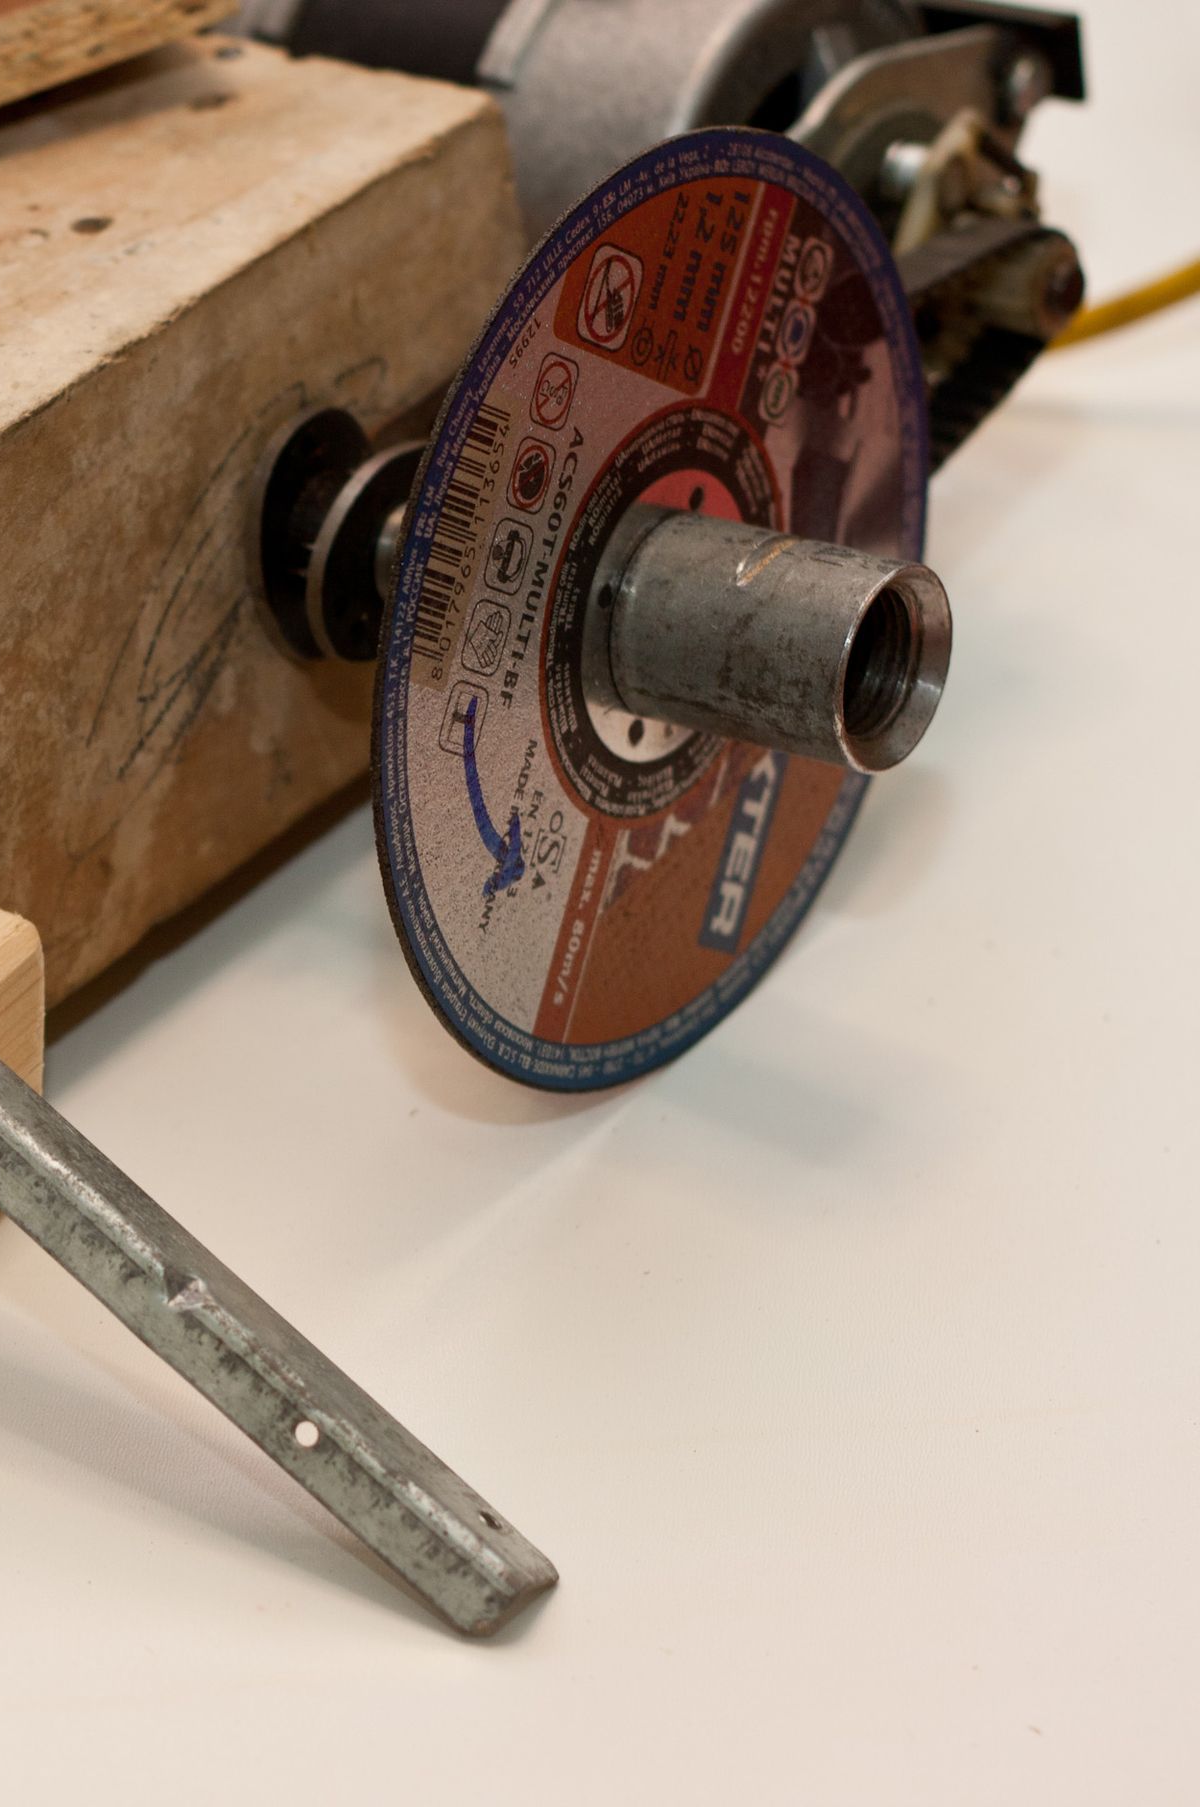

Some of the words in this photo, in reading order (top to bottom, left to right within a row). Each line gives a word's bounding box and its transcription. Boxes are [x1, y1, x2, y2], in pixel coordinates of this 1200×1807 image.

[663, 190, 689, 259] 22,23
[696, 190, 724, 244] 1,2
[720, 191, 751, 255] 125
[649, 261, 669, 311] mm
[673, 250, 703, 323] mm
[697, 261, 728, 333] mm
[757, 235, 803, 355] MULTI
[508, 317, 542, 370] 12995
[392, 600, 407, 644] 14122
[435, 438, 451, 467] Rue
[447, 384, 474, 437] Chanzy
[525, 266, 542, 295] 712
[542, 239, 564, 272] LILLE
[564, 210, 591, 246] Cedex
[431, 665, 444, 682] 8
[438, 544, 478, 654] 017965
[472, 420, 511, 528] 113654
[500, 425, 585, 711] ACS60T-MULTI-BF
[513, 738, 538, 801] MADE
[526, 789, 545, 820] EN
[709, 749, 777, 937] XTER
[578, 849, 603, 910] max.
[553, 918, 586, 1006] 80m/s
